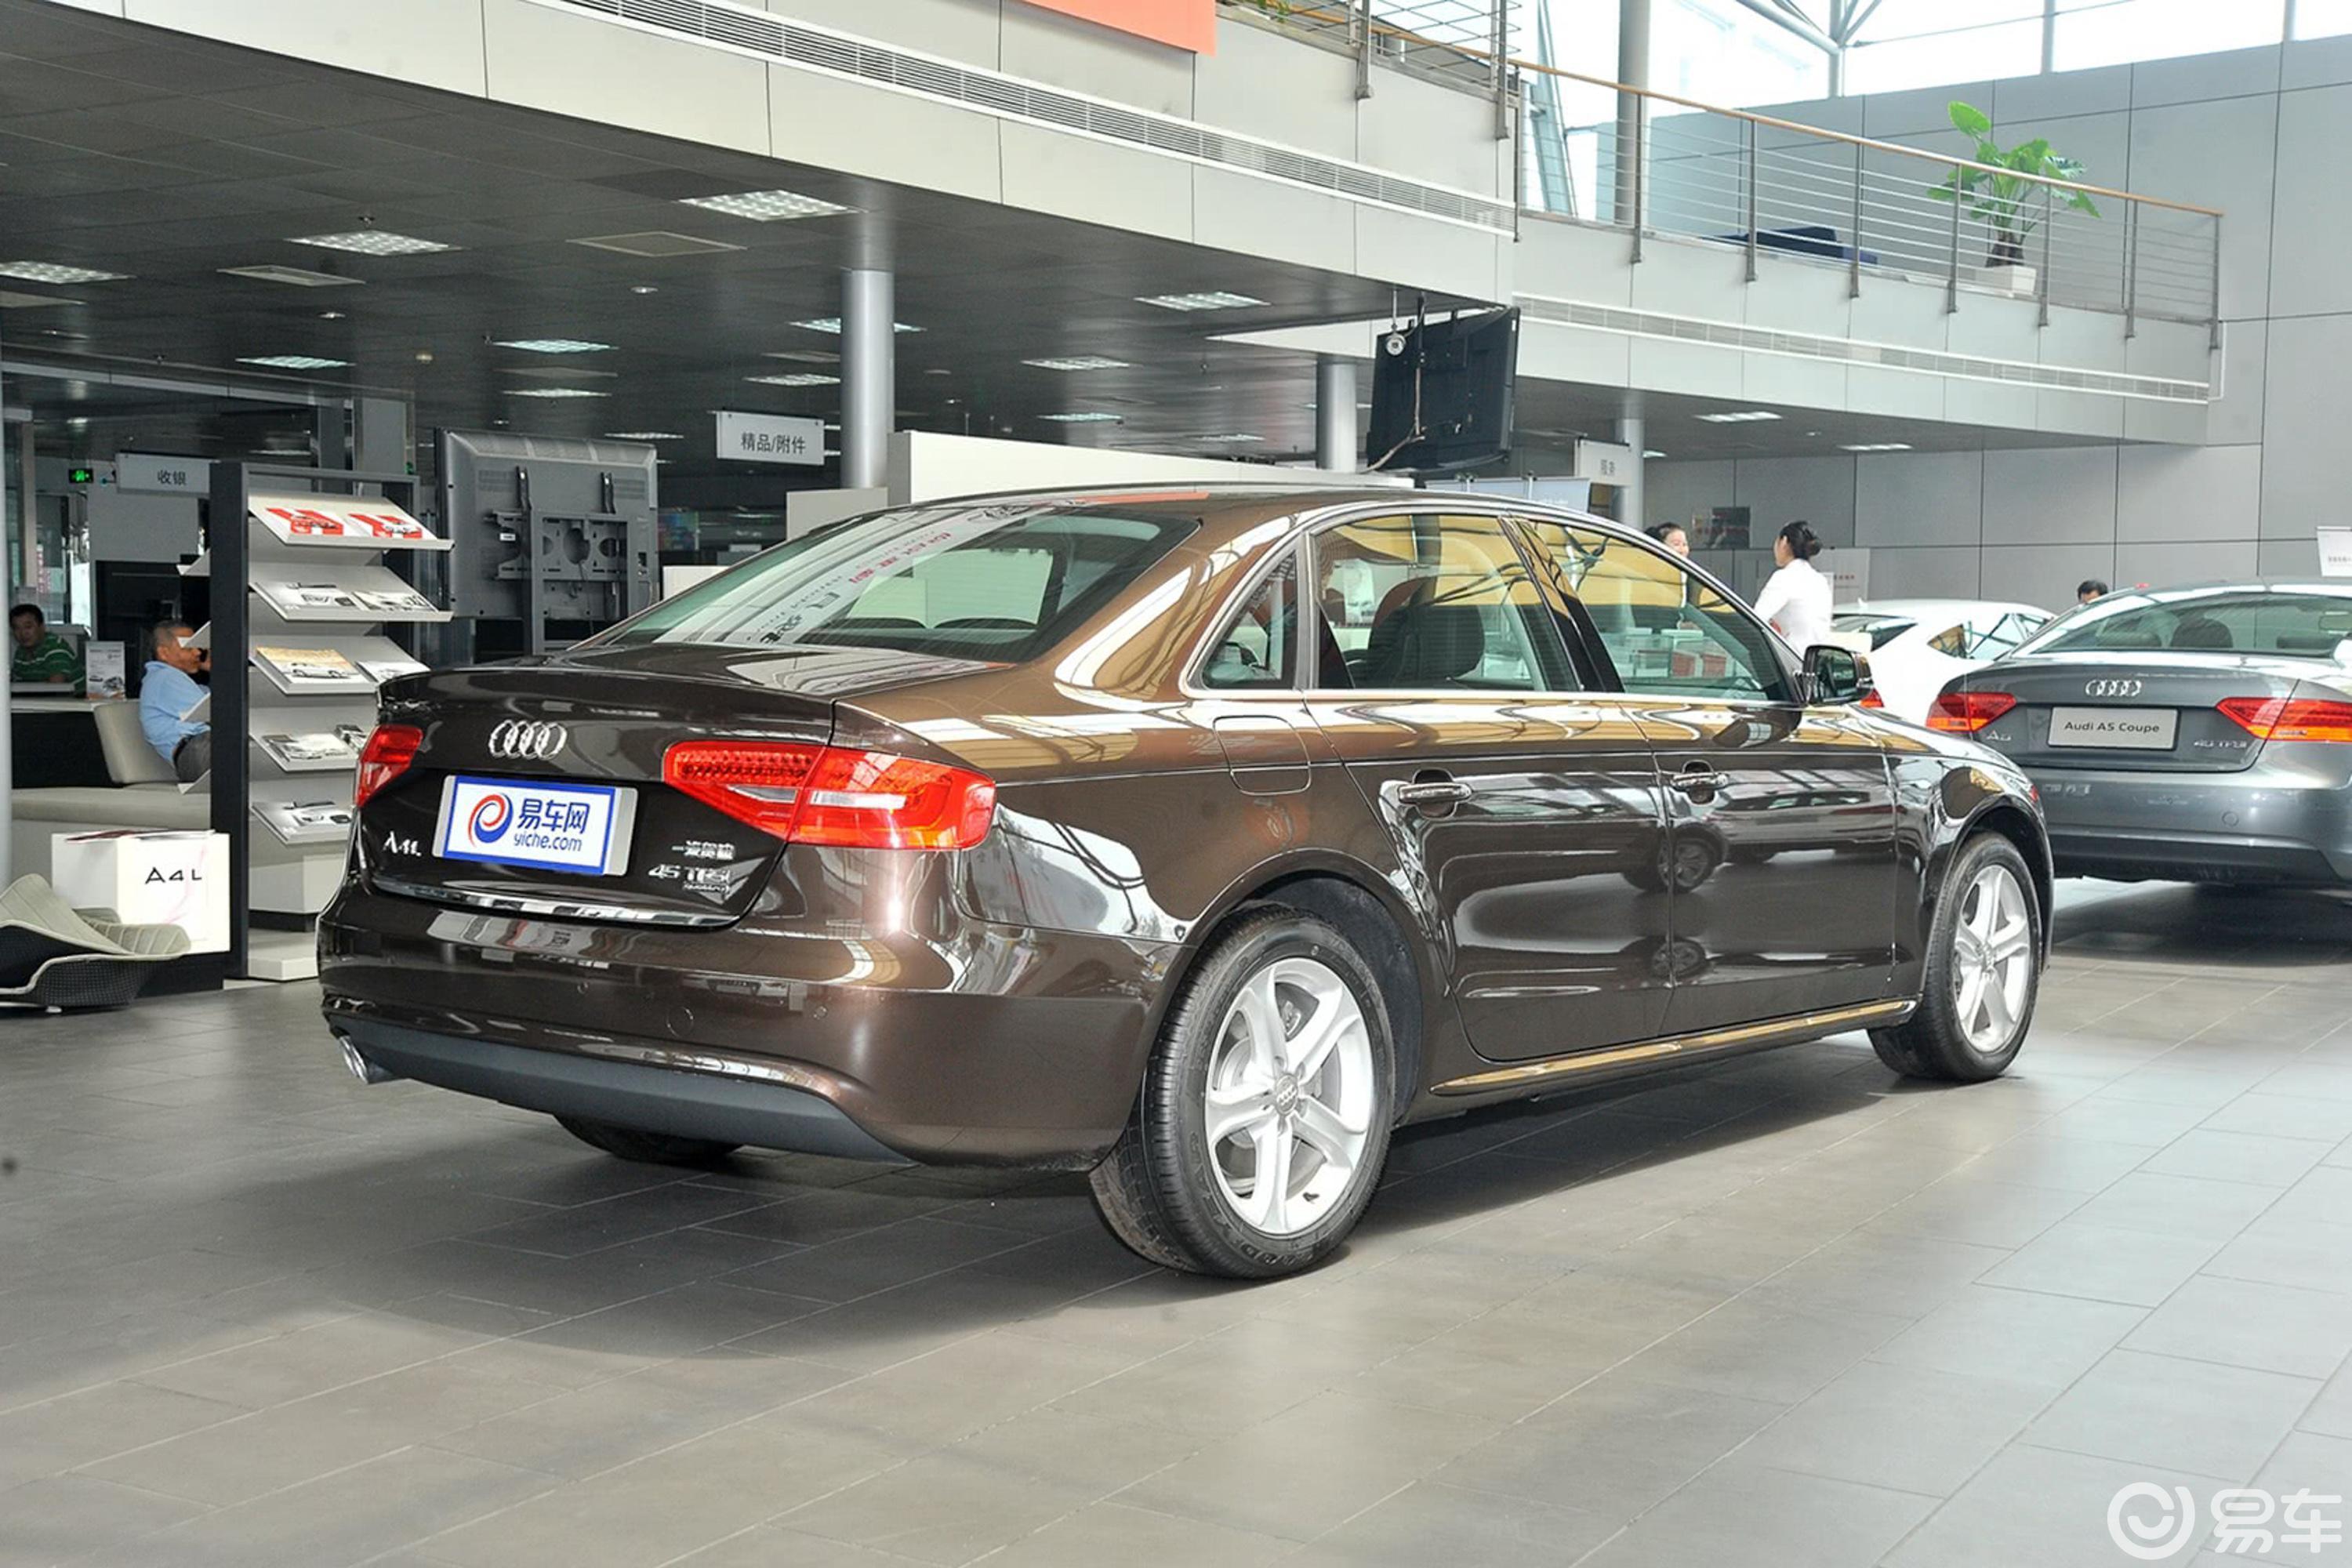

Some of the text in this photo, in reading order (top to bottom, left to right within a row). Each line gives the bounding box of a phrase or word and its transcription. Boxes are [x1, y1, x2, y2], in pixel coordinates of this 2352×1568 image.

[741, 432, 806, 454] 精品/附件
[158, 470, 187, 485] 收银
[2064, 720, 2160, 735] Audi A5 Coupe
[517, 797, 590, 834] 易车网
[514, 831, 583, 852] yiche.com
[144, 866, 202, 884] A4L
